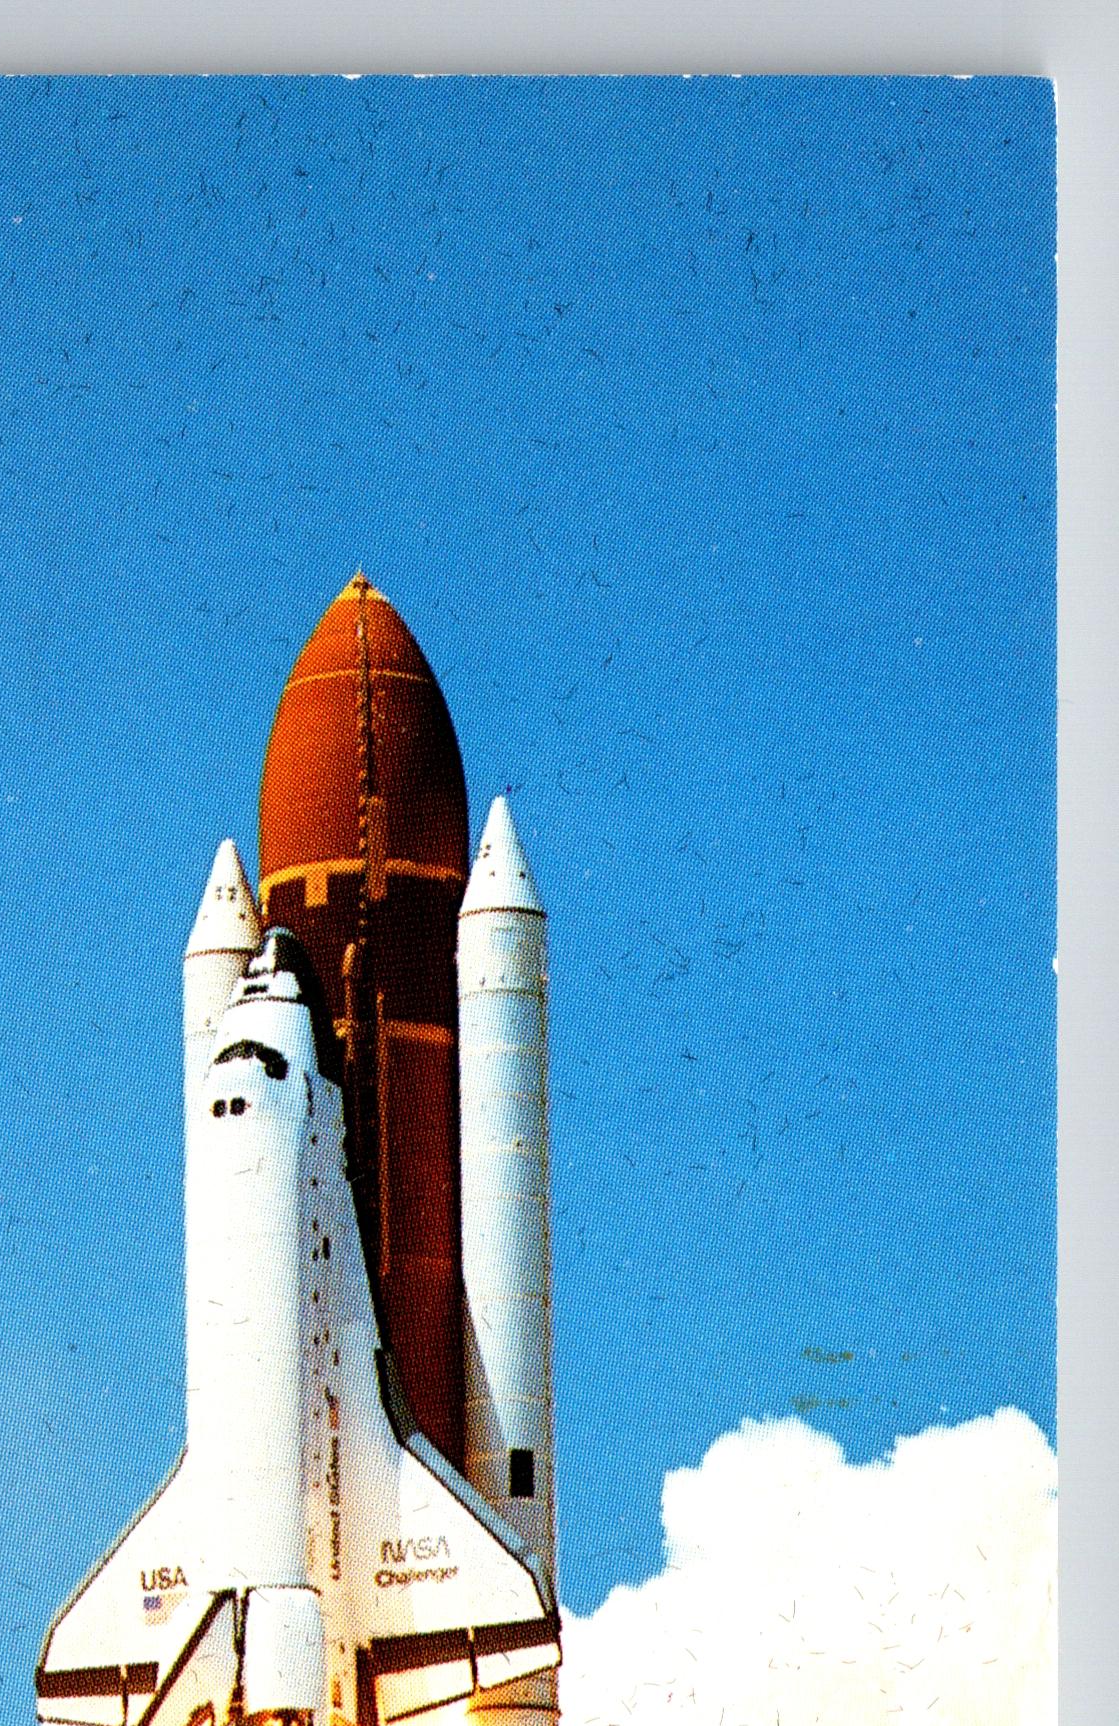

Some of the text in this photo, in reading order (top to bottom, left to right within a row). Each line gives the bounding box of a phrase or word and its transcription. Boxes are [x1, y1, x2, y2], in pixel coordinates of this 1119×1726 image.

[380, 1536, 450, 1563] NASA
[140, 1566, 188, 1591] USA
[374, 1566, 459, 1588] Challenger
